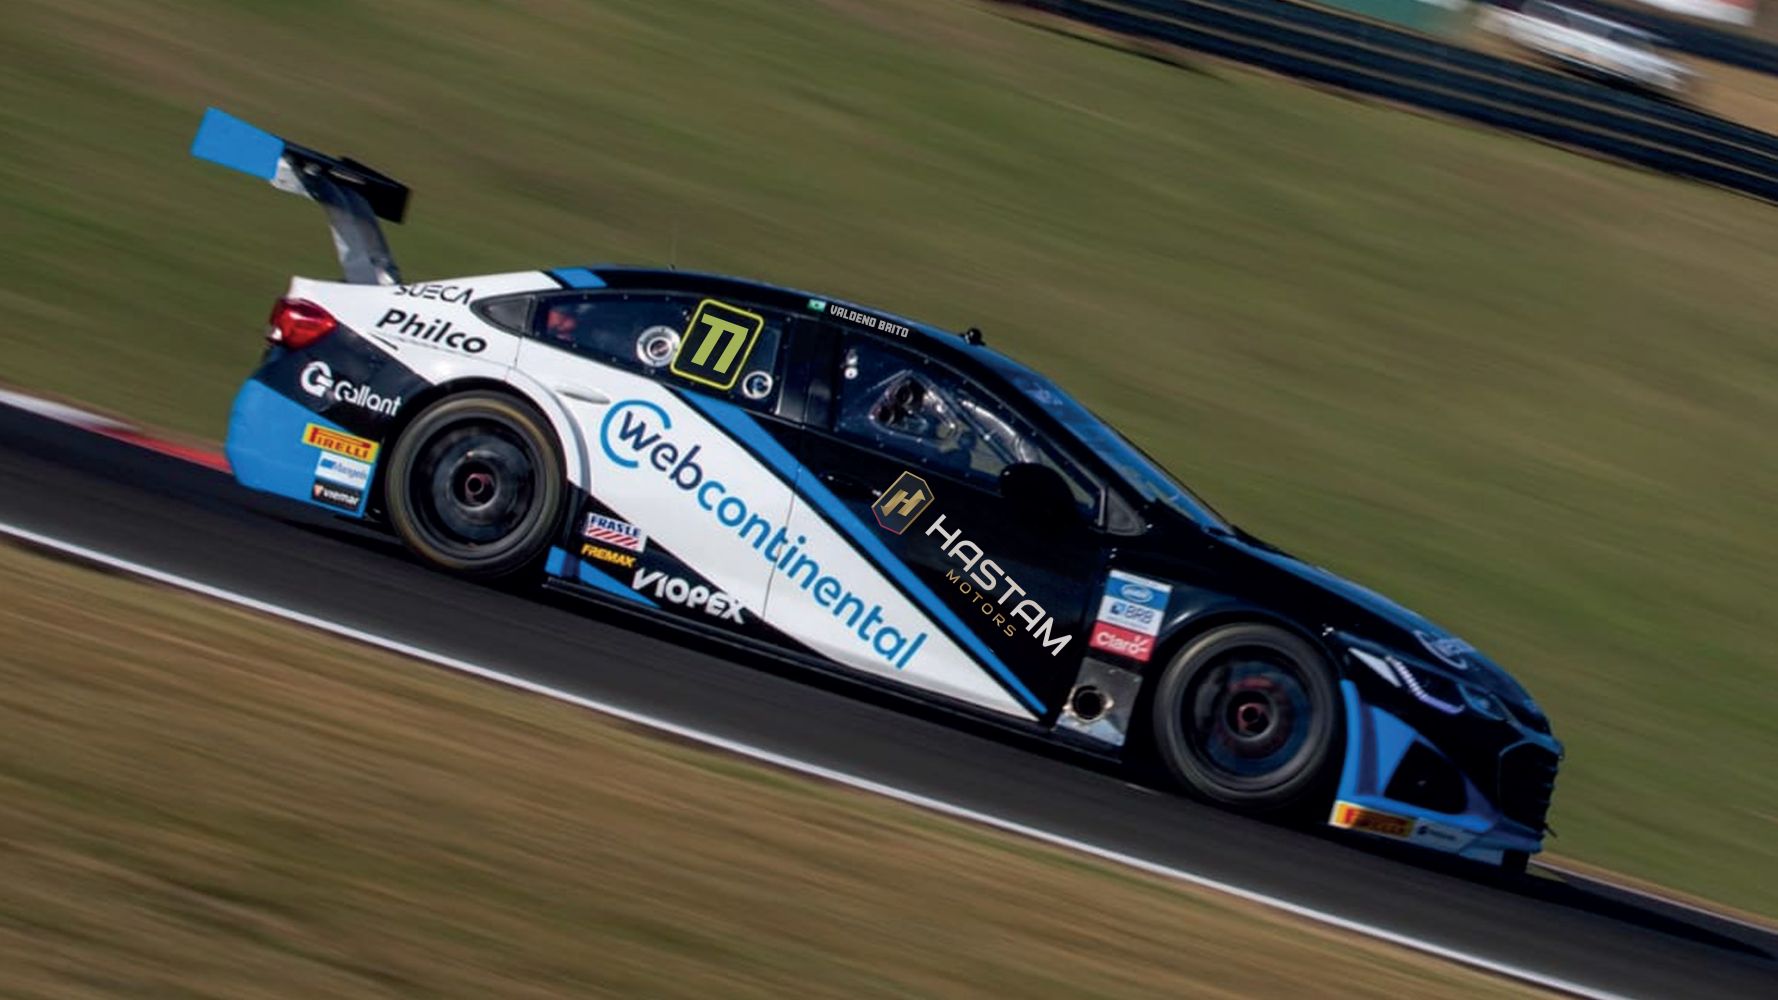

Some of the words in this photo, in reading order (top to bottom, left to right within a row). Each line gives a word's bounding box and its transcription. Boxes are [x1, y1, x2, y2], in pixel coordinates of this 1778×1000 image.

[376, 308, 487, 353] Philco
[830, 304, 877, 328] VALDENO
[877, 319, 909, 338] BRITO
[334, 380, 401, 416] Gallant
[308, 426, 371, 459] PIRELLI
[591, 515, 642, 538] FRASLE
[581, 543, 637, 568] FREMAX
[631, 568, 745, 624] VIOPEX
[925, 514, 1072, 656] HASTAM
[946, 569, 1016, 637] MOTORS
[1097, 632, 1140, 654] Claro
